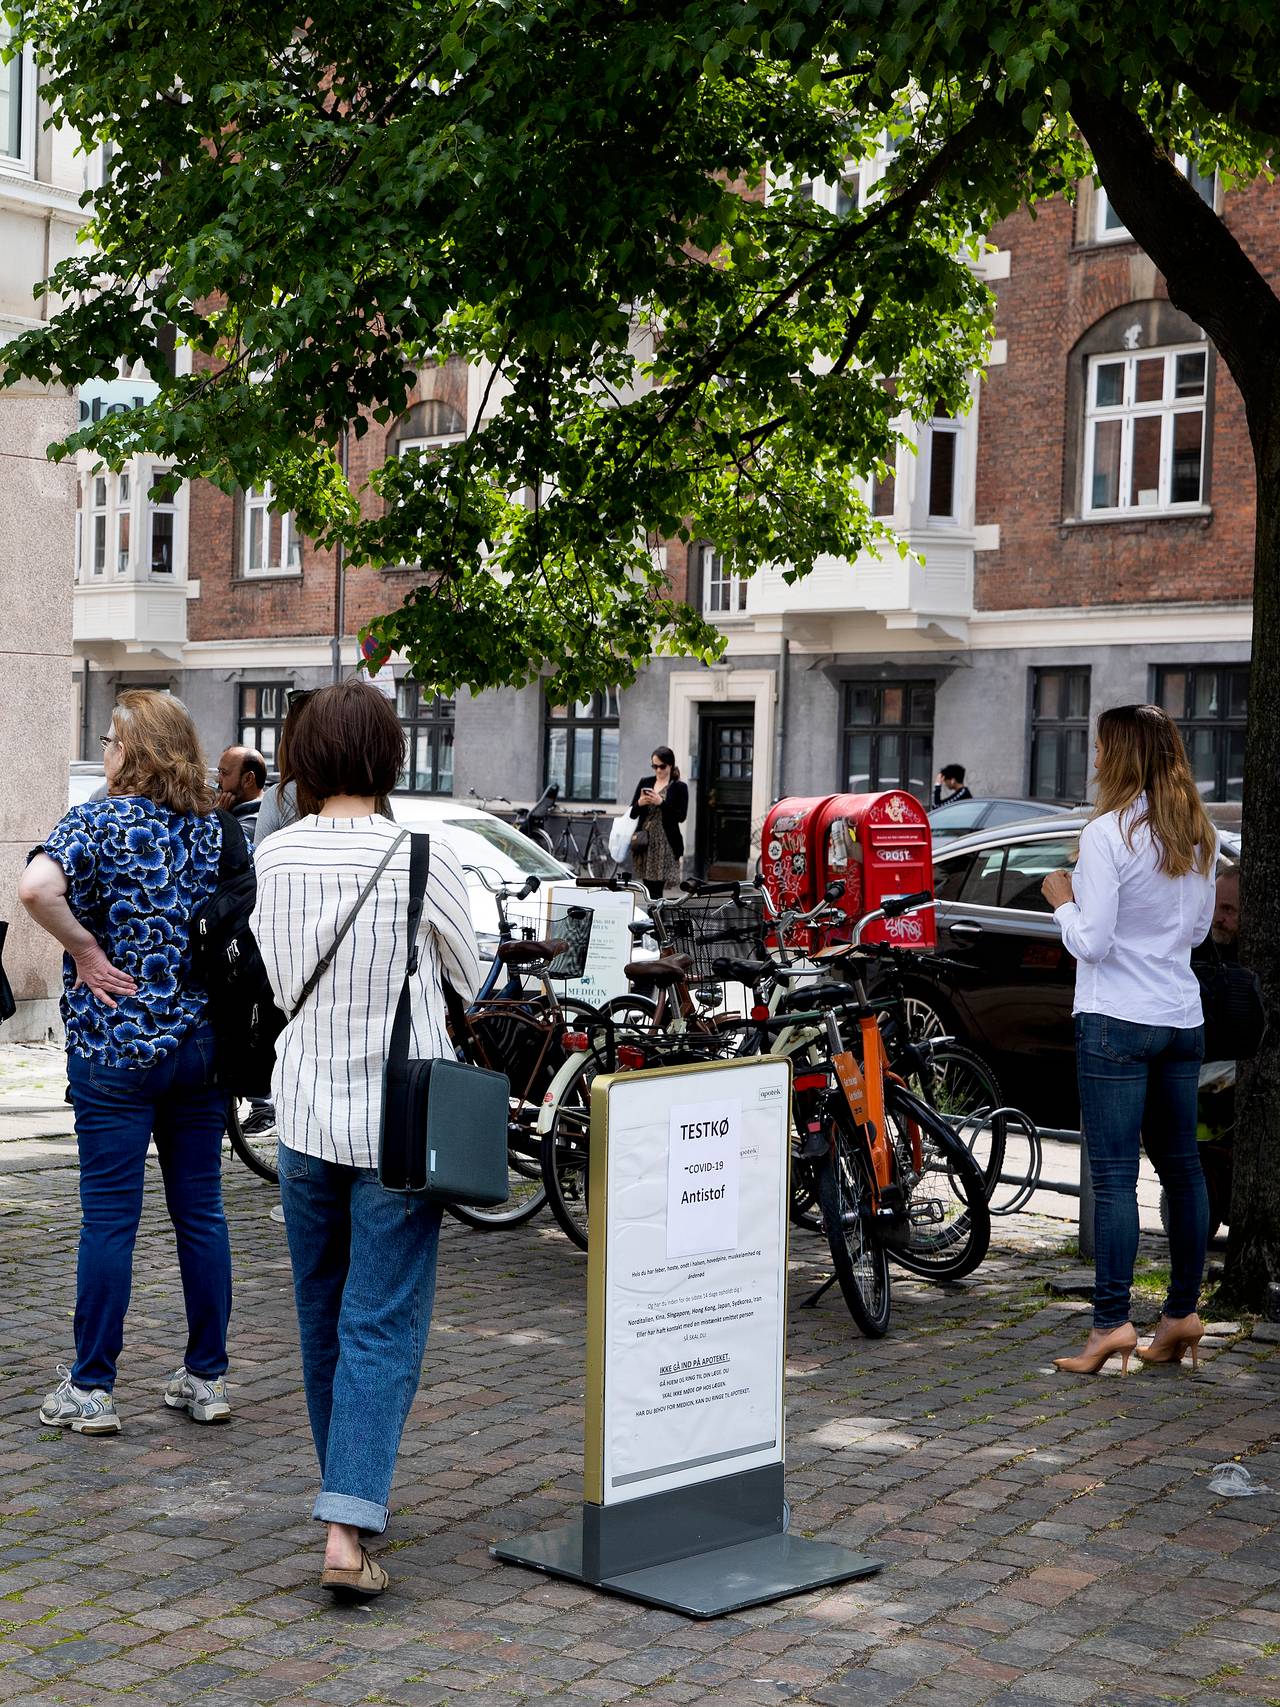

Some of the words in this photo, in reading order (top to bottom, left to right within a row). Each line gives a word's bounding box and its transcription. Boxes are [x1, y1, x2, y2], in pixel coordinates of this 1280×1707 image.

[568, 987, 607, 997] MEDICIN
[760, 1088, 781, 1098] apotek
[680, 1117, 729, 1140] TESTKØ
[681, 1184, 726, 1205] Antistof
[666, 1309, 691, 1319] Singapore,
[691, 1306, 704, 1315] Hong
[683, 1321, 693, 1329] med
[659, 1364, 672, 1374] IKKE
[673, 1361, 680, 1371] GÅ
[681, 1360, 692, 1369] IND
[693, 1357, 701, 1367] PÅ
